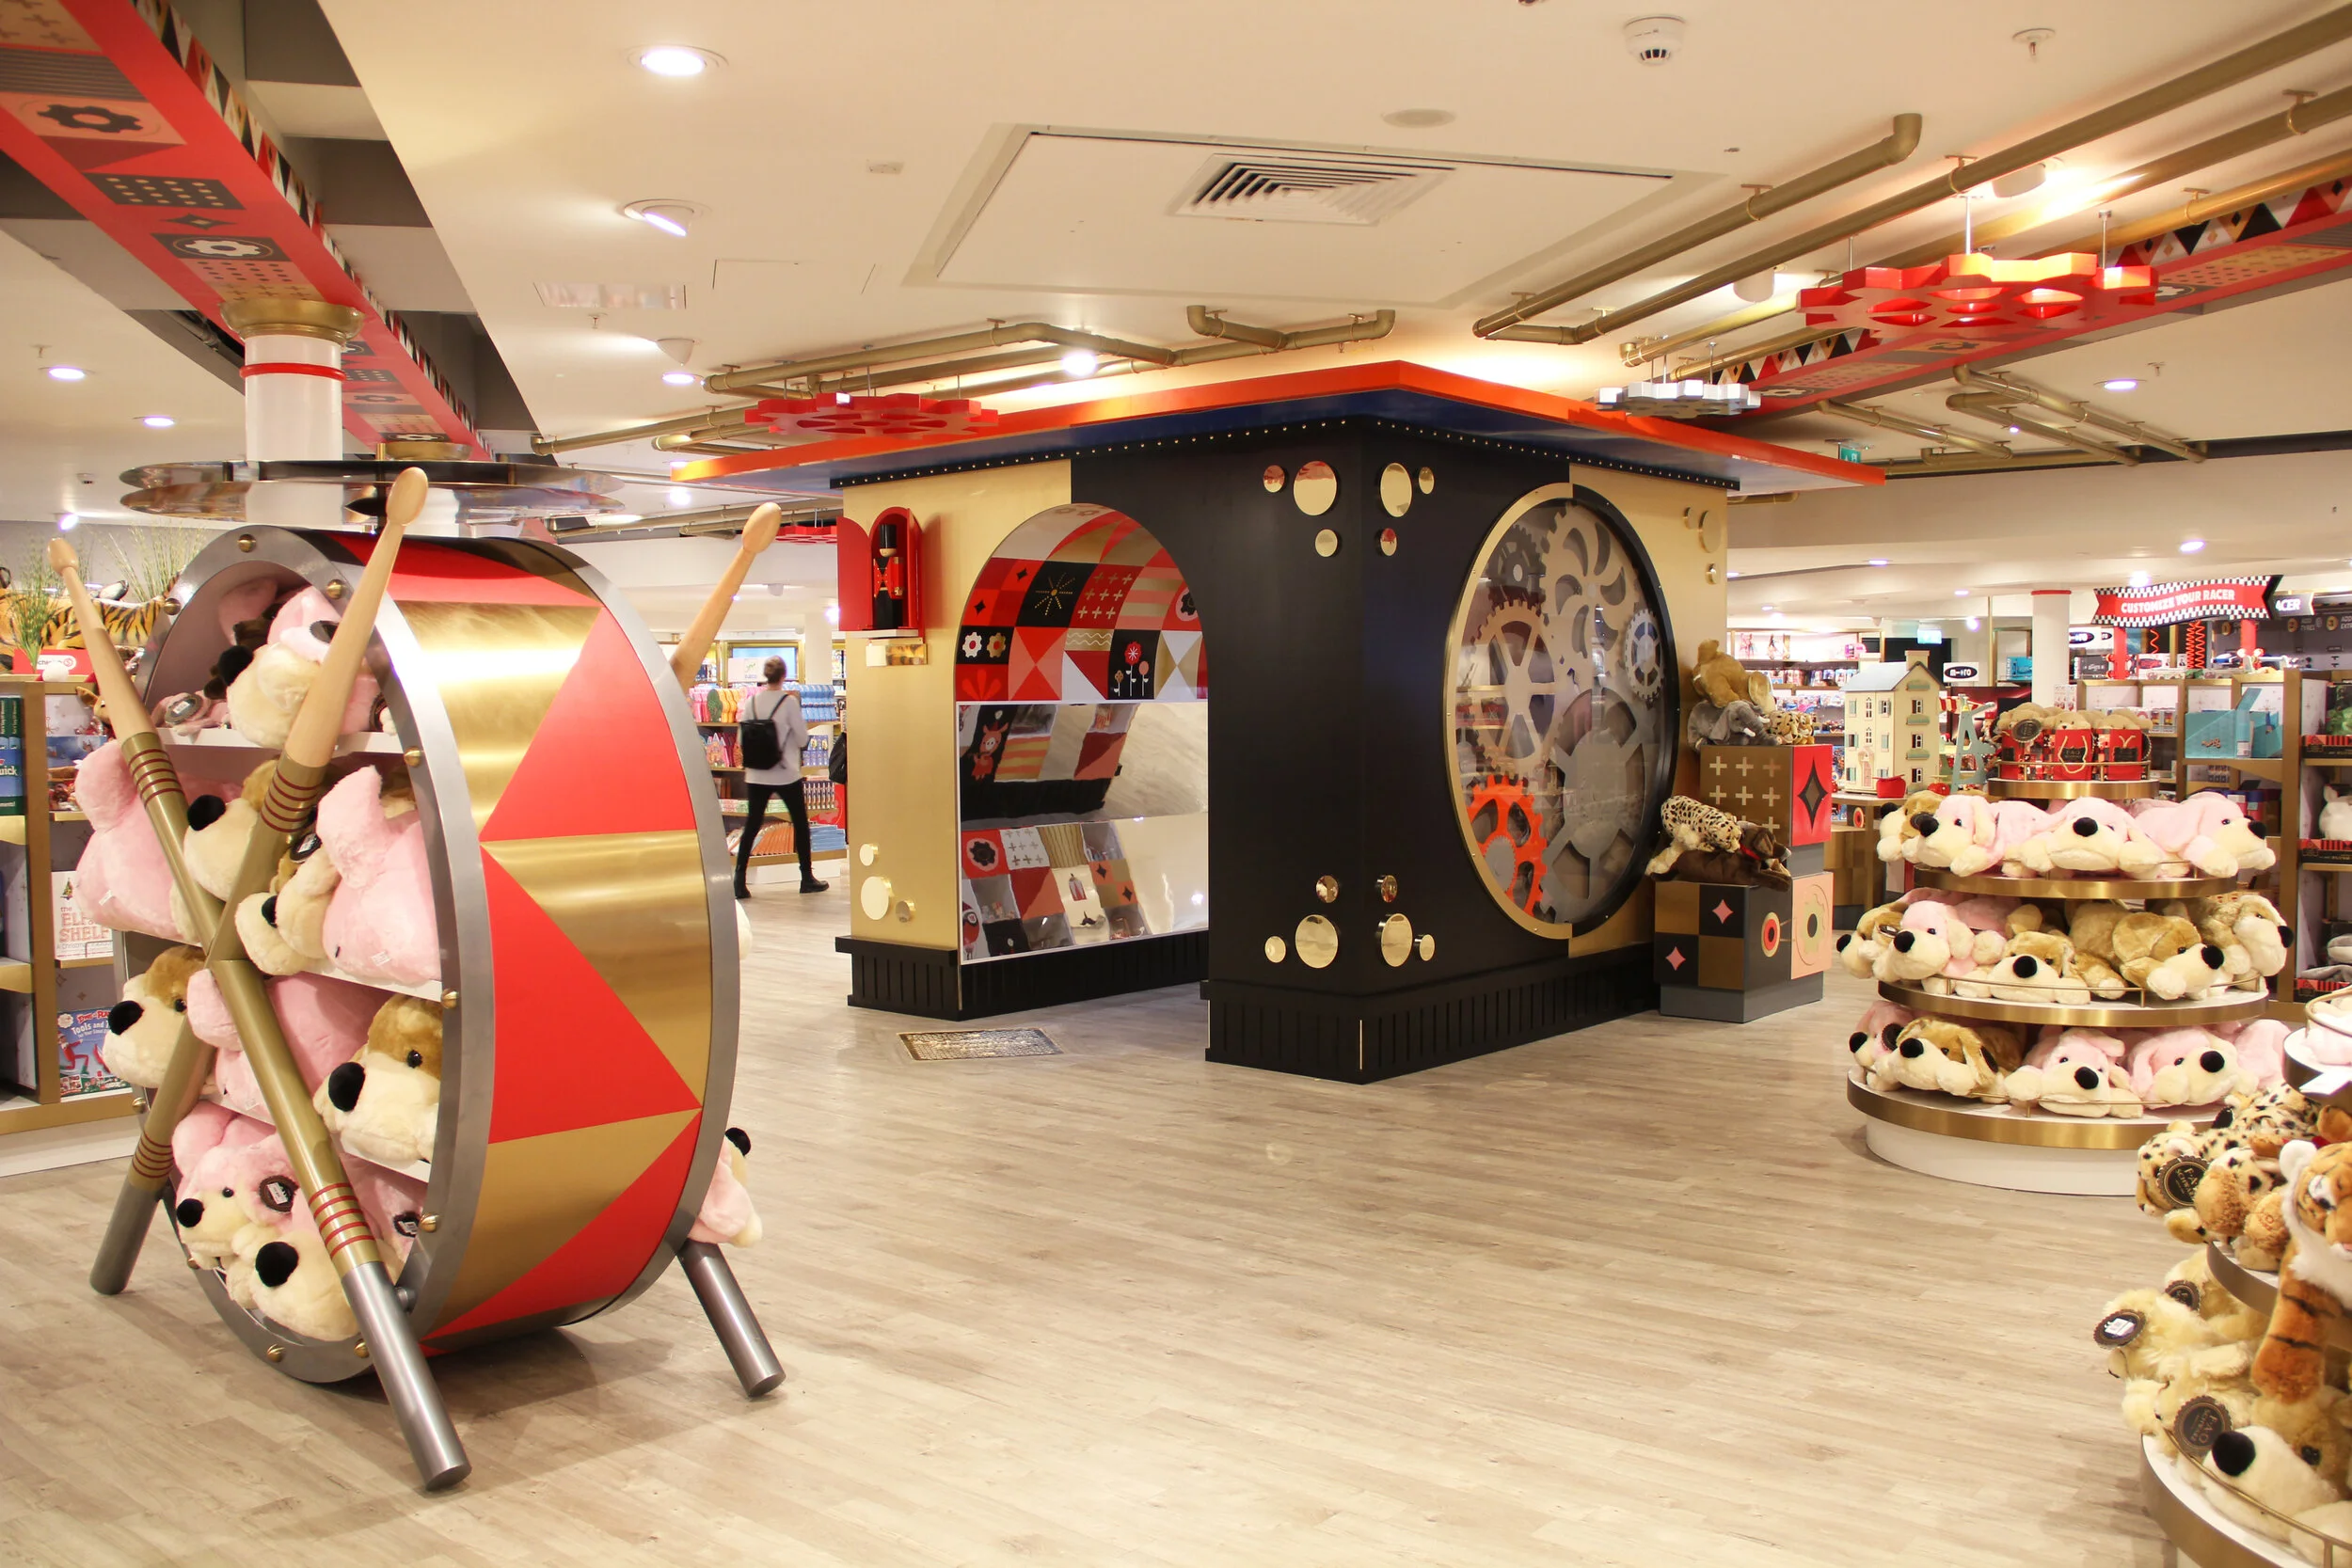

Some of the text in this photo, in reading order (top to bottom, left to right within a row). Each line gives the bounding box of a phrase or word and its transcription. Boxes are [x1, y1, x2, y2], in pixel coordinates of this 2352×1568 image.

[2175, 590, 2201, 606] YOUR
[2202, 589, 2235, 601] RACER
[2276, 598, 2301, 610] ACER
[59, 926, 110, 943] SHELF
[71, 1021, 91, 1036] Tools
